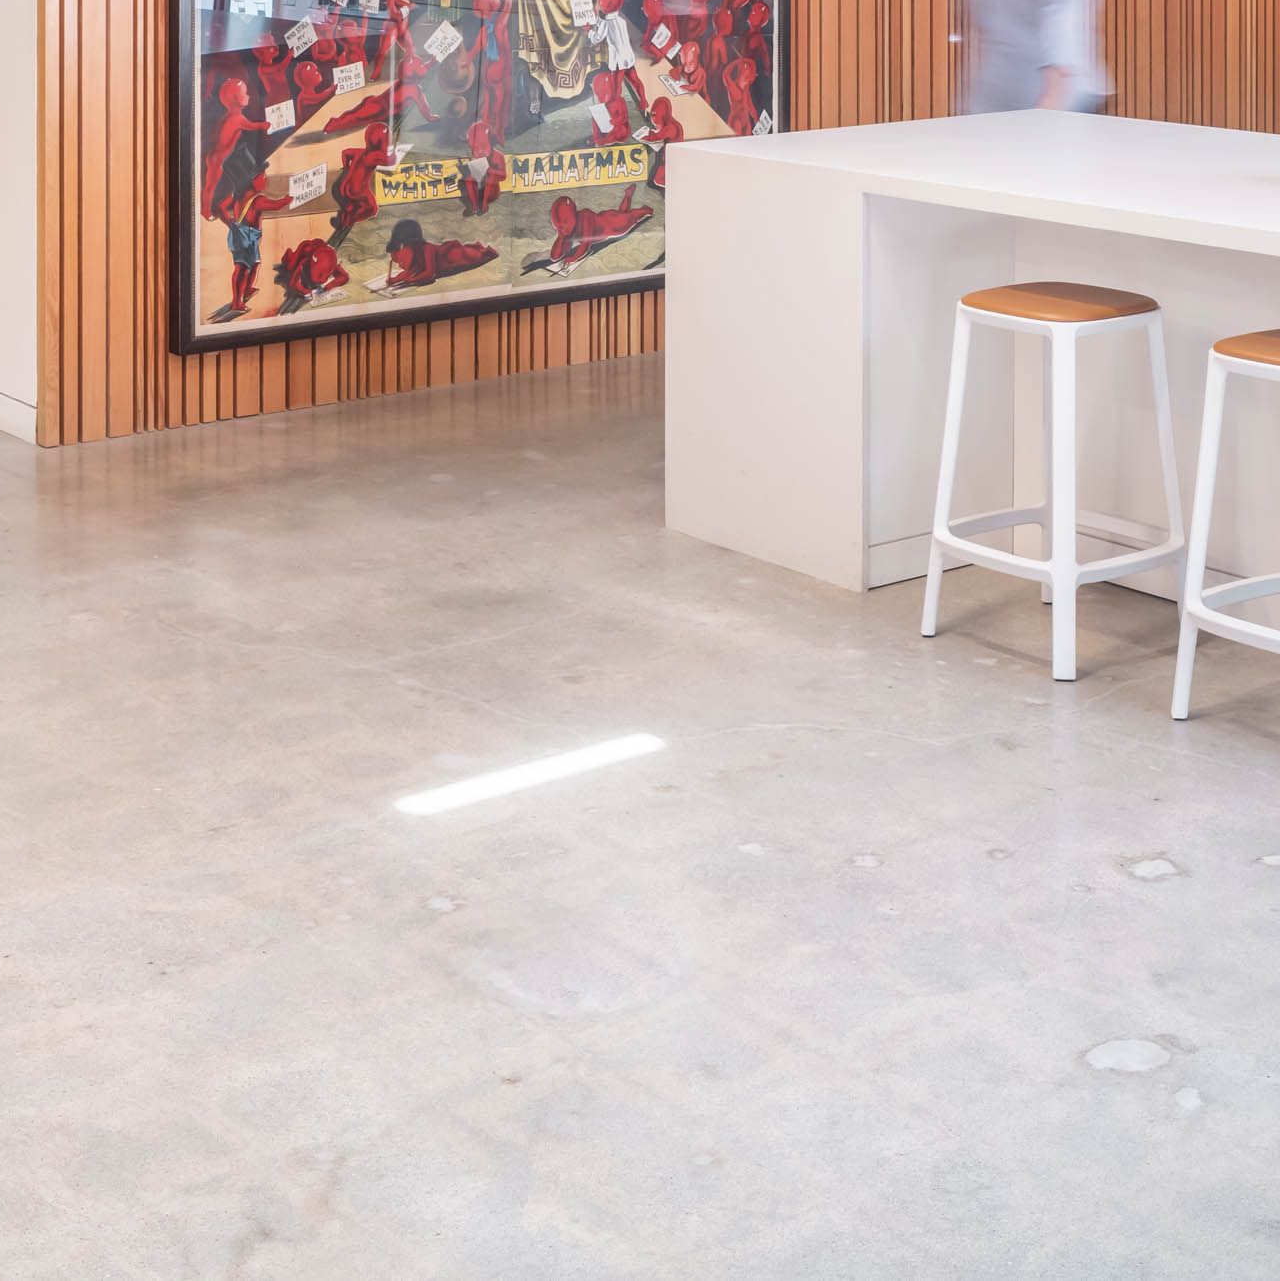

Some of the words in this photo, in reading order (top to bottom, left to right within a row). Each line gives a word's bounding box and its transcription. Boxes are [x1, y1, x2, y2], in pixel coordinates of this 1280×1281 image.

[295, 37, 313, 53] RING
[339, 82, 361, 92] RICH
[381, 174, 459, 199] WHITE
[512, 148, 644, 188] MAHATMAS
[400, 163, 444, 178] THE
